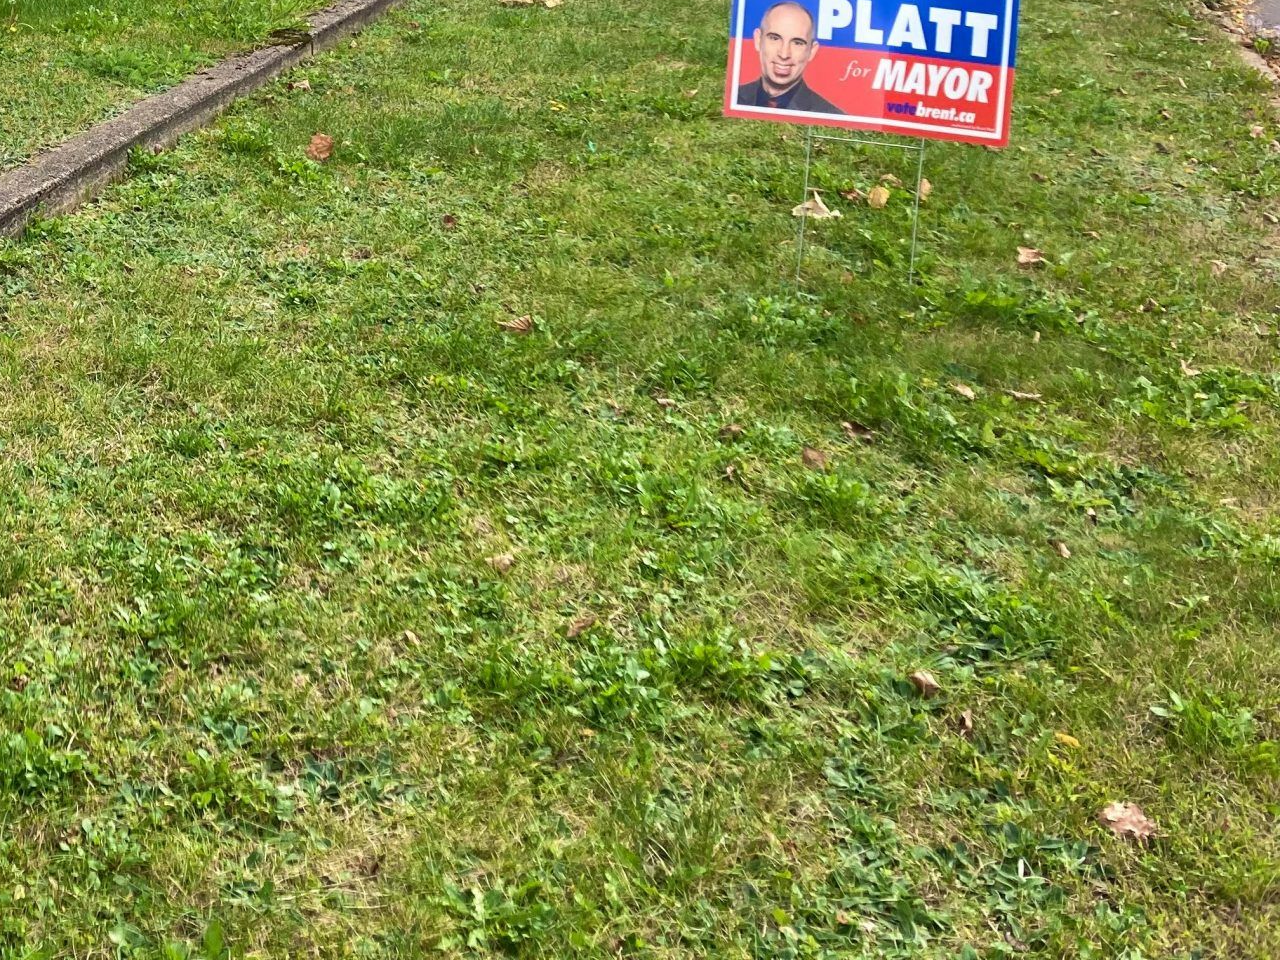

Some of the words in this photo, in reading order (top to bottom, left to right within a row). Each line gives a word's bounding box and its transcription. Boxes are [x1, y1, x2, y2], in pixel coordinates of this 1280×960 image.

[839, 60, 872, 82] for
[871, 58, 993, 104] MAYOR
[886, 100, 976, 125] votebrent.ca
